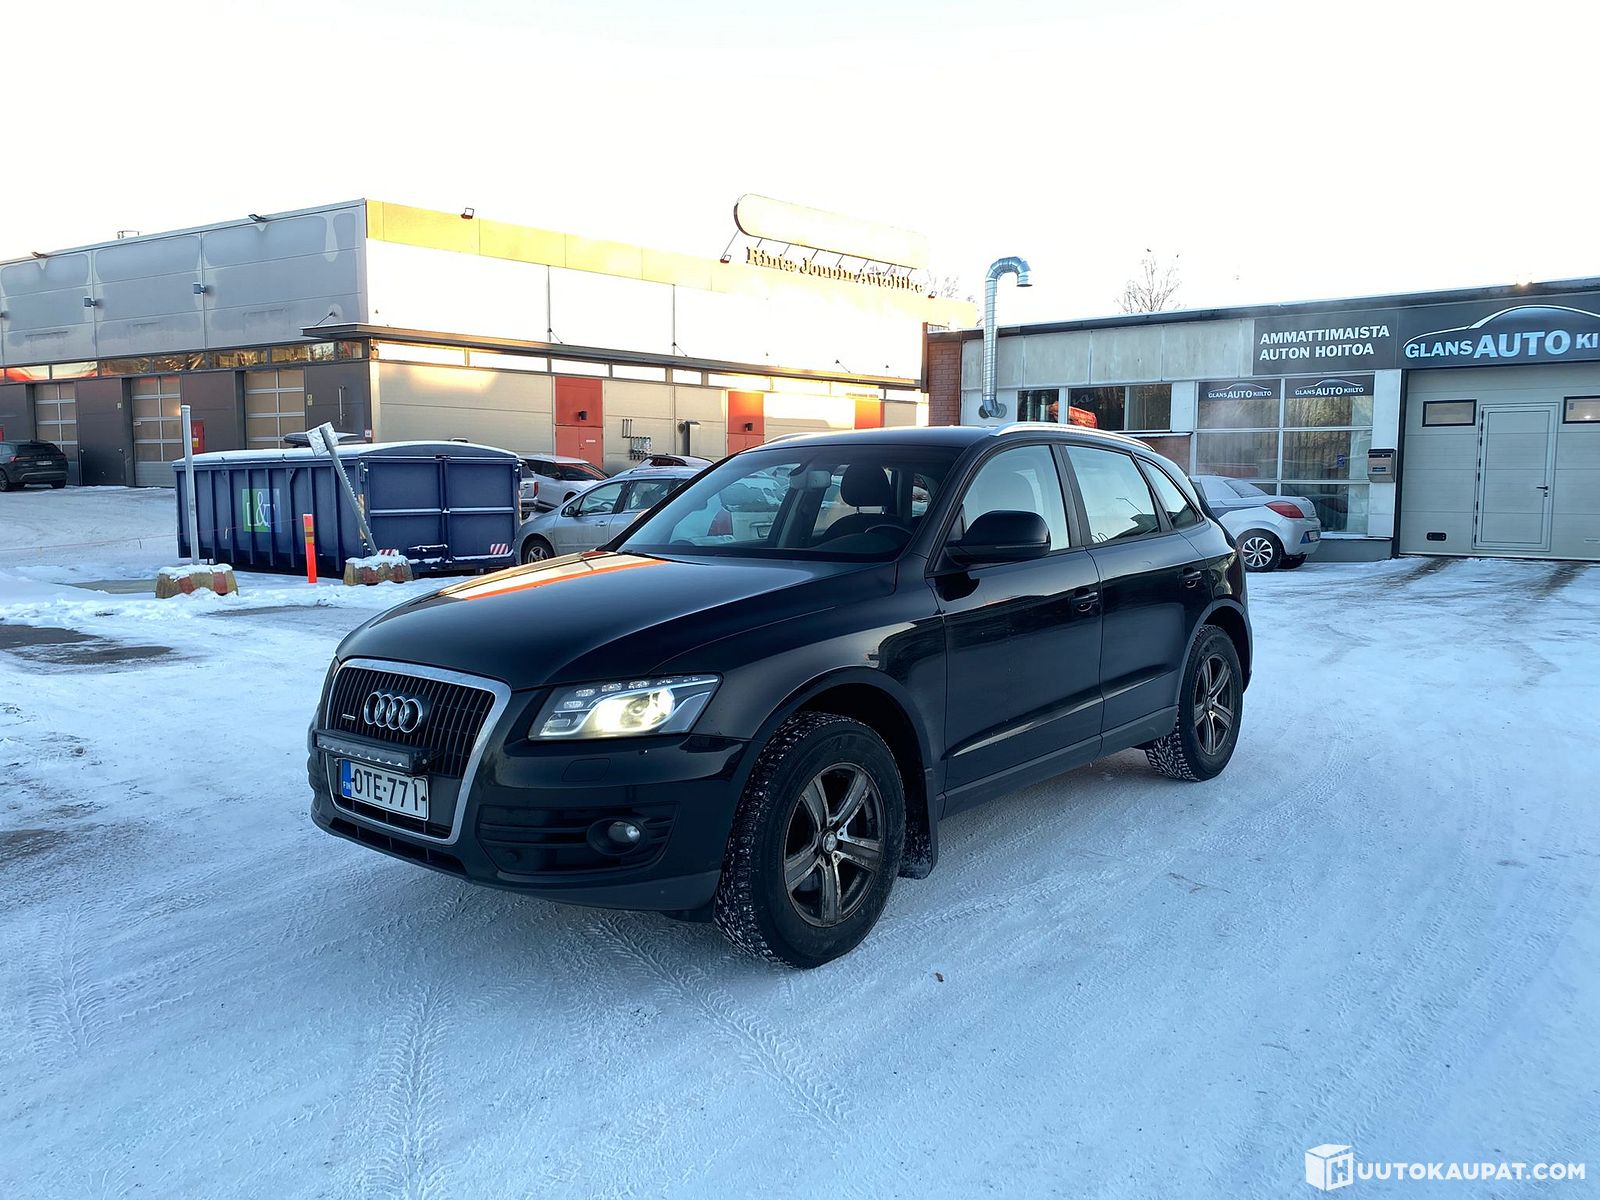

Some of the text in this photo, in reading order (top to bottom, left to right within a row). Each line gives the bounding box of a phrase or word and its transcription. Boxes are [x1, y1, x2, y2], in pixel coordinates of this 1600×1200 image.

[1259, 325, 1390, 345] AMMATTIMAISTA
[1259, 343, 1375, 360] AUTON HOITOA
[1405, 341, 1473, 358] GLANS
[1473, 330, 1571, 359] AUTO
[1227, 390, 1252, 399] AUTO
[1316, 387, 1343, 396] AUTO
[354, 768, 419, 811] OTE-771
